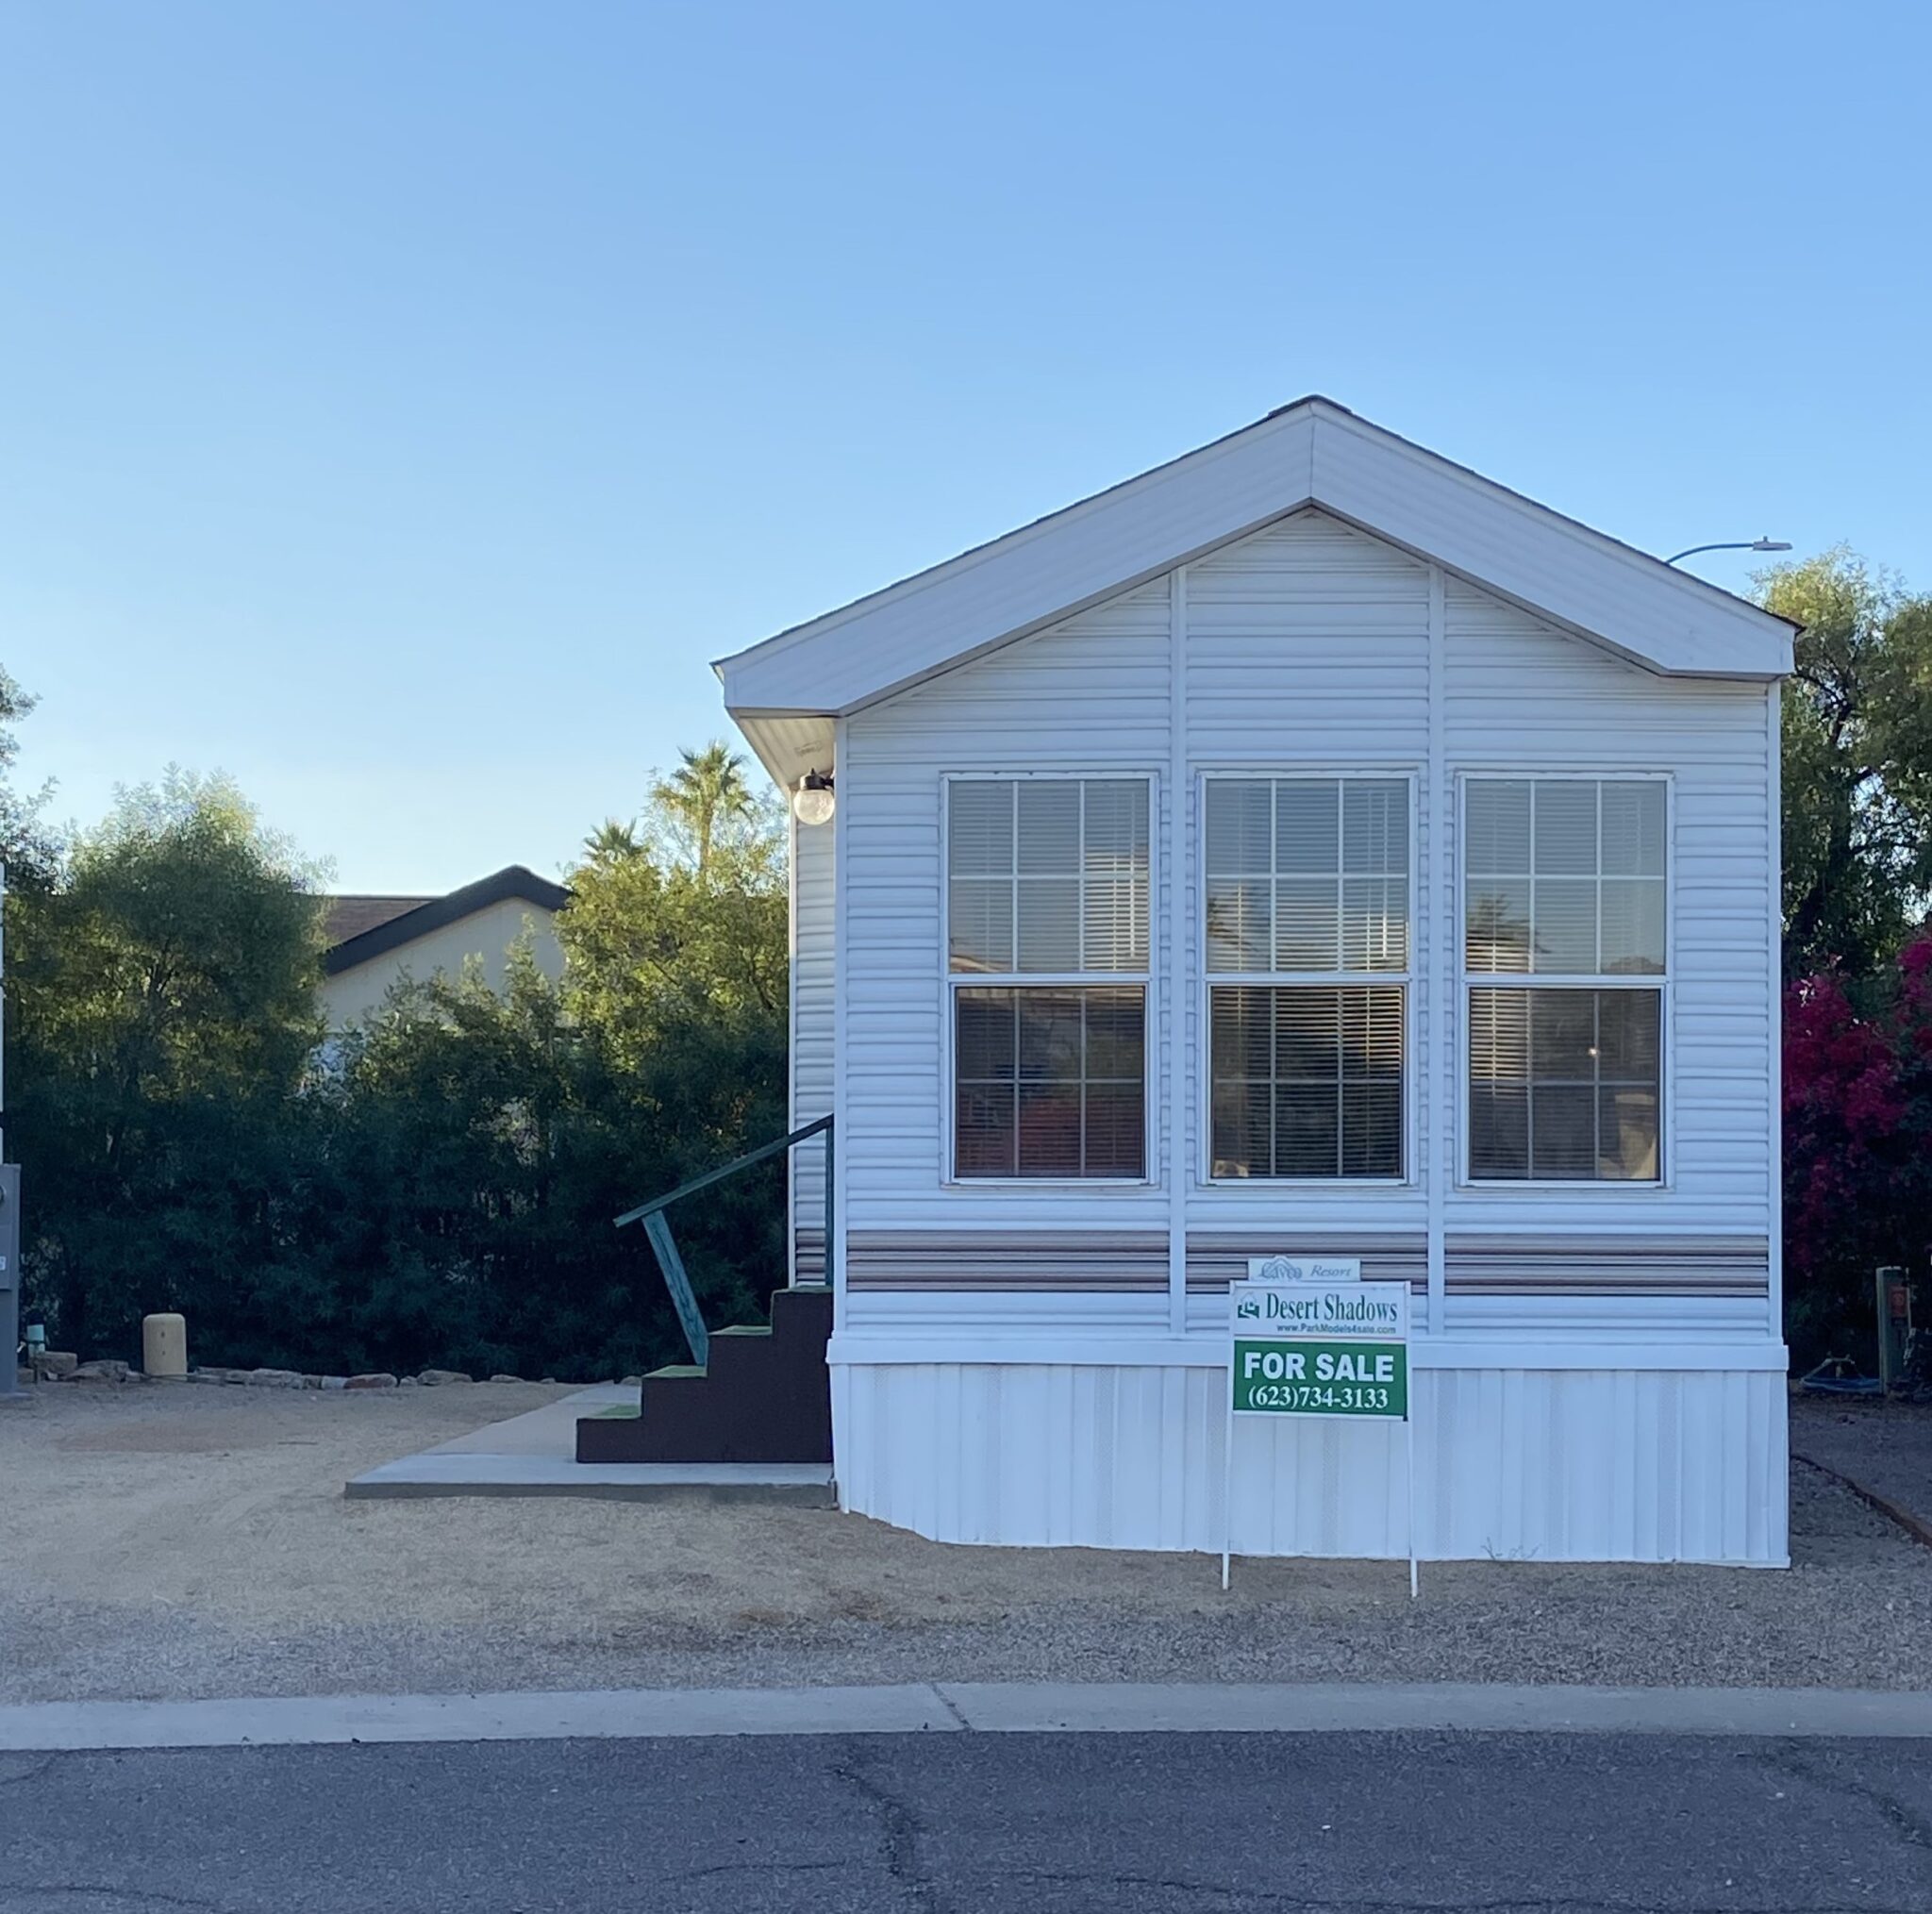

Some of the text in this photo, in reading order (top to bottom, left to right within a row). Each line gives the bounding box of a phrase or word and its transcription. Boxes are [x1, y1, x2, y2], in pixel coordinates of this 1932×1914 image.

[1310, 1265, 1353, 1277] Resort
[1266, 1292, 1398, 1322] Desert Shadows
[1244, 1352, 1394, 1382] FOR SALE
[1248, 1385, 1389, 1409] (623)734-3133
